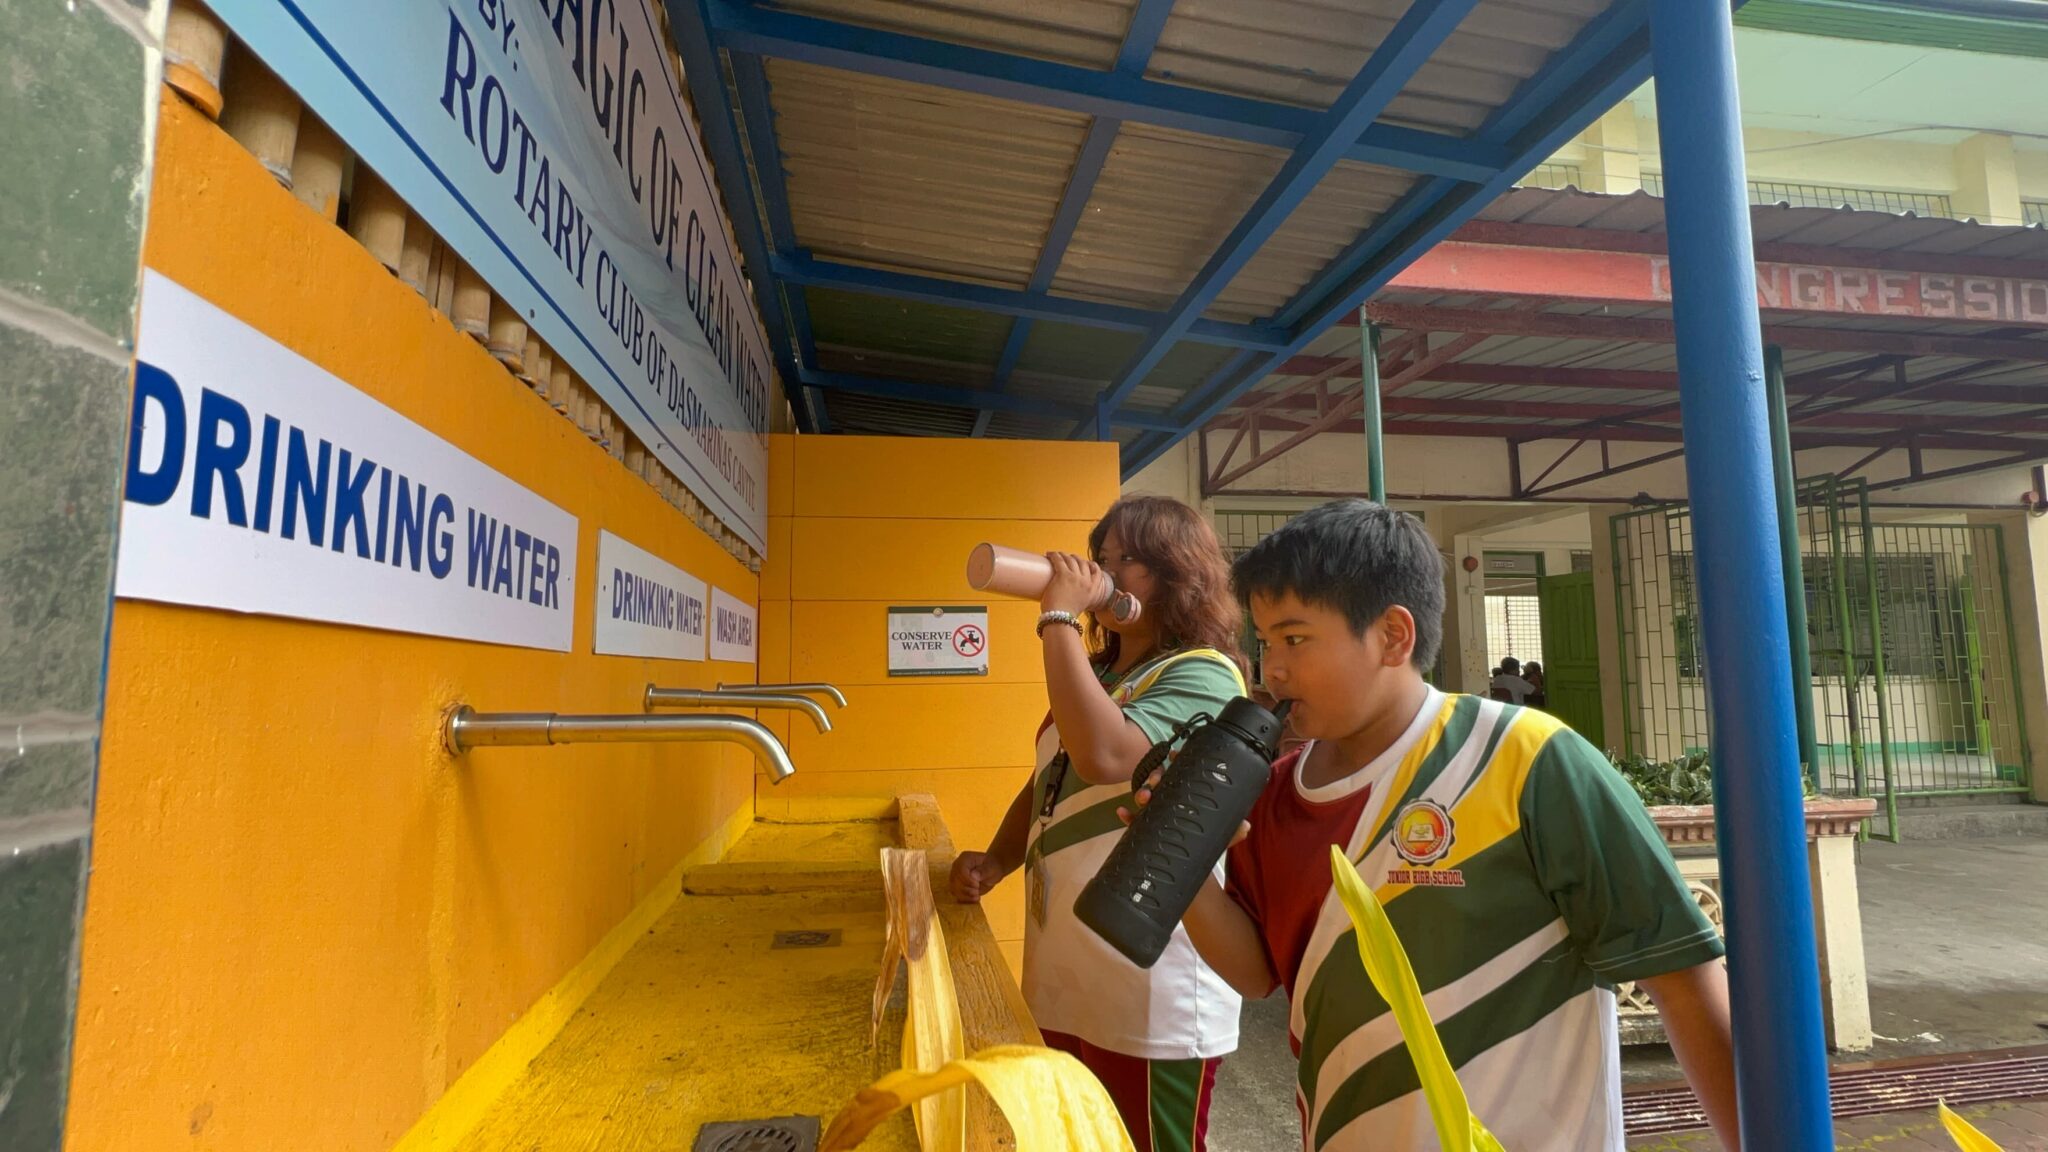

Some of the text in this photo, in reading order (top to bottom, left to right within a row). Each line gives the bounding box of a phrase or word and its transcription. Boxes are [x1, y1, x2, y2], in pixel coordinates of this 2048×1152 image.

[539, 0, 769, 450] AGIC OF CLEAN WATER
[439, 6, 593, 290] ROTARY
[596, 250, 644, 366] CLUB
[647, 331, 667, 396] OF
[733, 455, 756, 512] CAVITE
[1651, 255, 2048, 322] CNGRESSIO
[124, 359, 560, 610] DRINKING WATER
[612, 567, 703, 637] DRINKING WATER
[716, 606, 753, 647] WASH AREA
[891, 631, 952, 641] CONSERVE
[902, 641, 943, 651] WATER
[1387, 870, 1464, 886] JUNIOR HIGH SCHOOL
